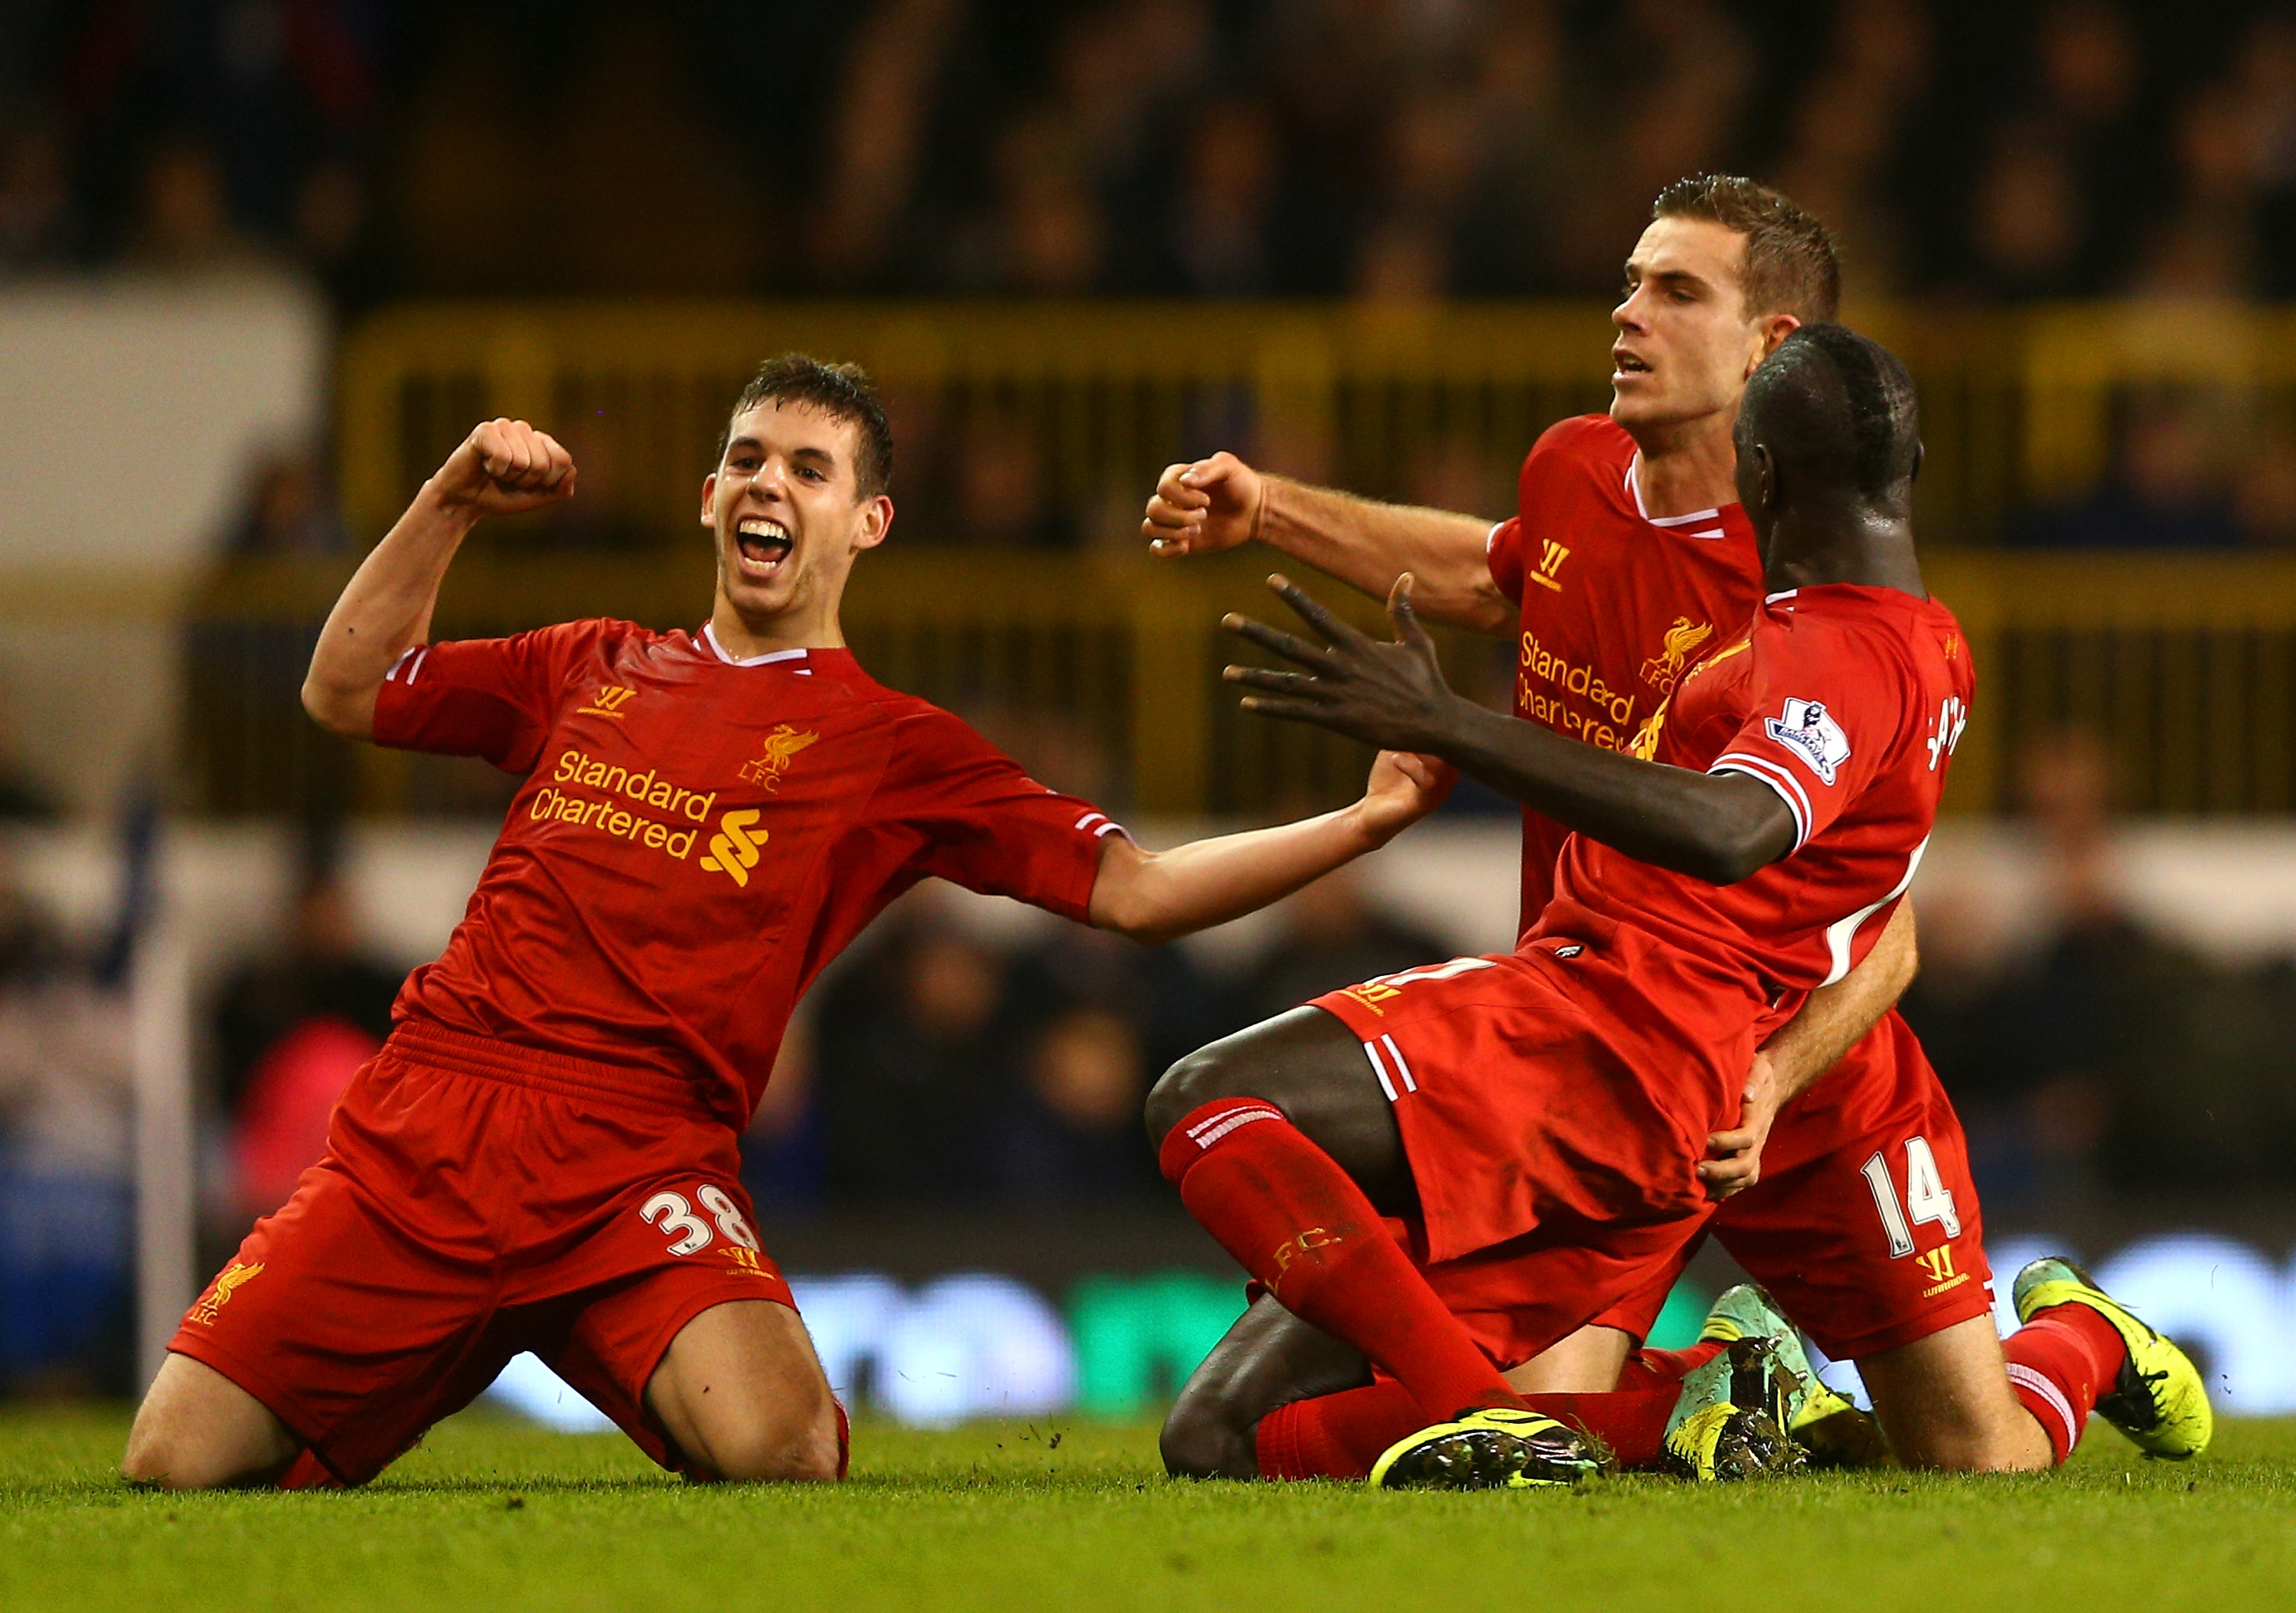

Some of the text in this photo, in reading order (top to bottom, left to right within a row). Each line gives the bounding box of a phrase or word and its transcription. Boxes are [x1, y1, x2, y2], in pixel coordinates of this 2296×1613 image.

[1521, 630, 1636, 726] Standard
[553, 749, 716, 823] Standard
[530, 787, 697, 860] Chartered
[639, 1184, 761, 1256] 38
[1860, 1135, 1962, 1260] 14
